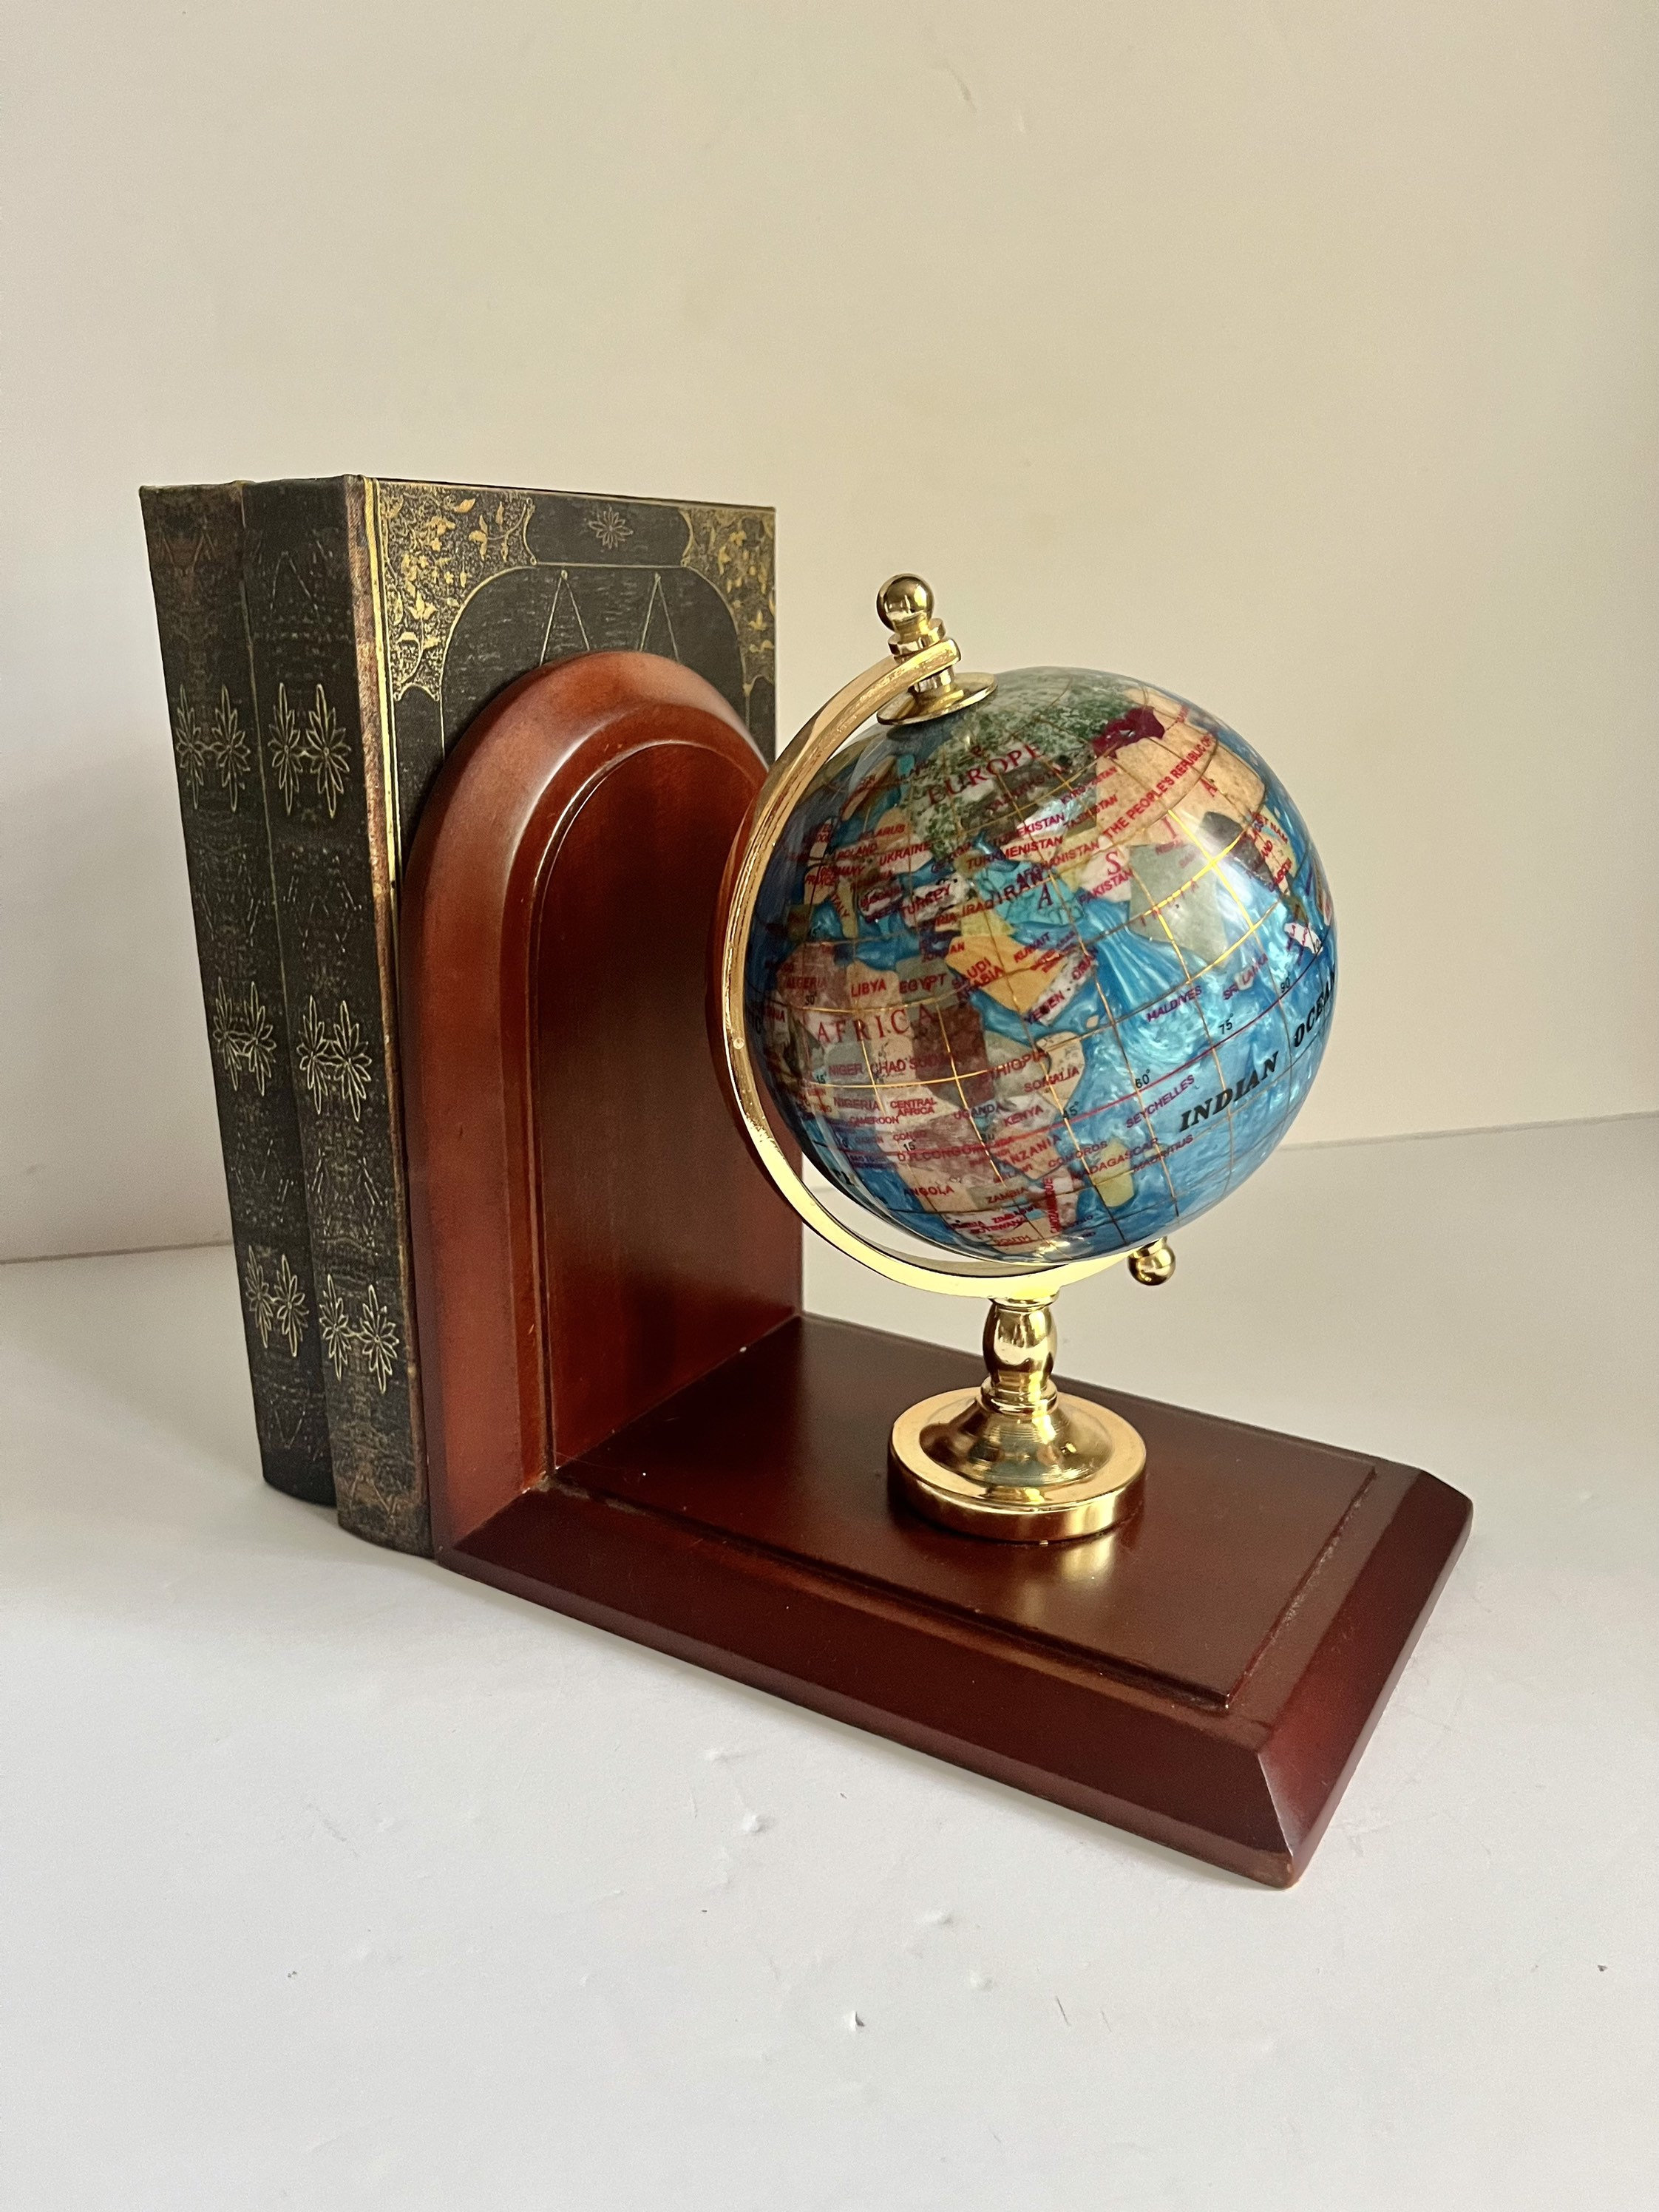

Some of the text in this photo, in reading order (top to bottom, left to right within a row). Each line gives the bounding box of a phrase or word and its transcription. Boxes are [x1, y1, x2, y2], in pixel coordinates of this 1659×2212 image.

[927, 743, 1045, 805] EUROPE
[1102, 814, 1130, 840] THE
[1126, 774, 1175, 821] PEOPLE'S
[850, 978, 887, 997] LIBYA
[1147, 985, 1203, 1022] MALDIVES
[818, 1003, 934, 1045] AFRICA
[890, 1097, 937, 1109] CENTRAL
[1126, 1074, 1195, 1128] SEYCHELLES
[1179, 1051, 1279, 1132] INDIAN
